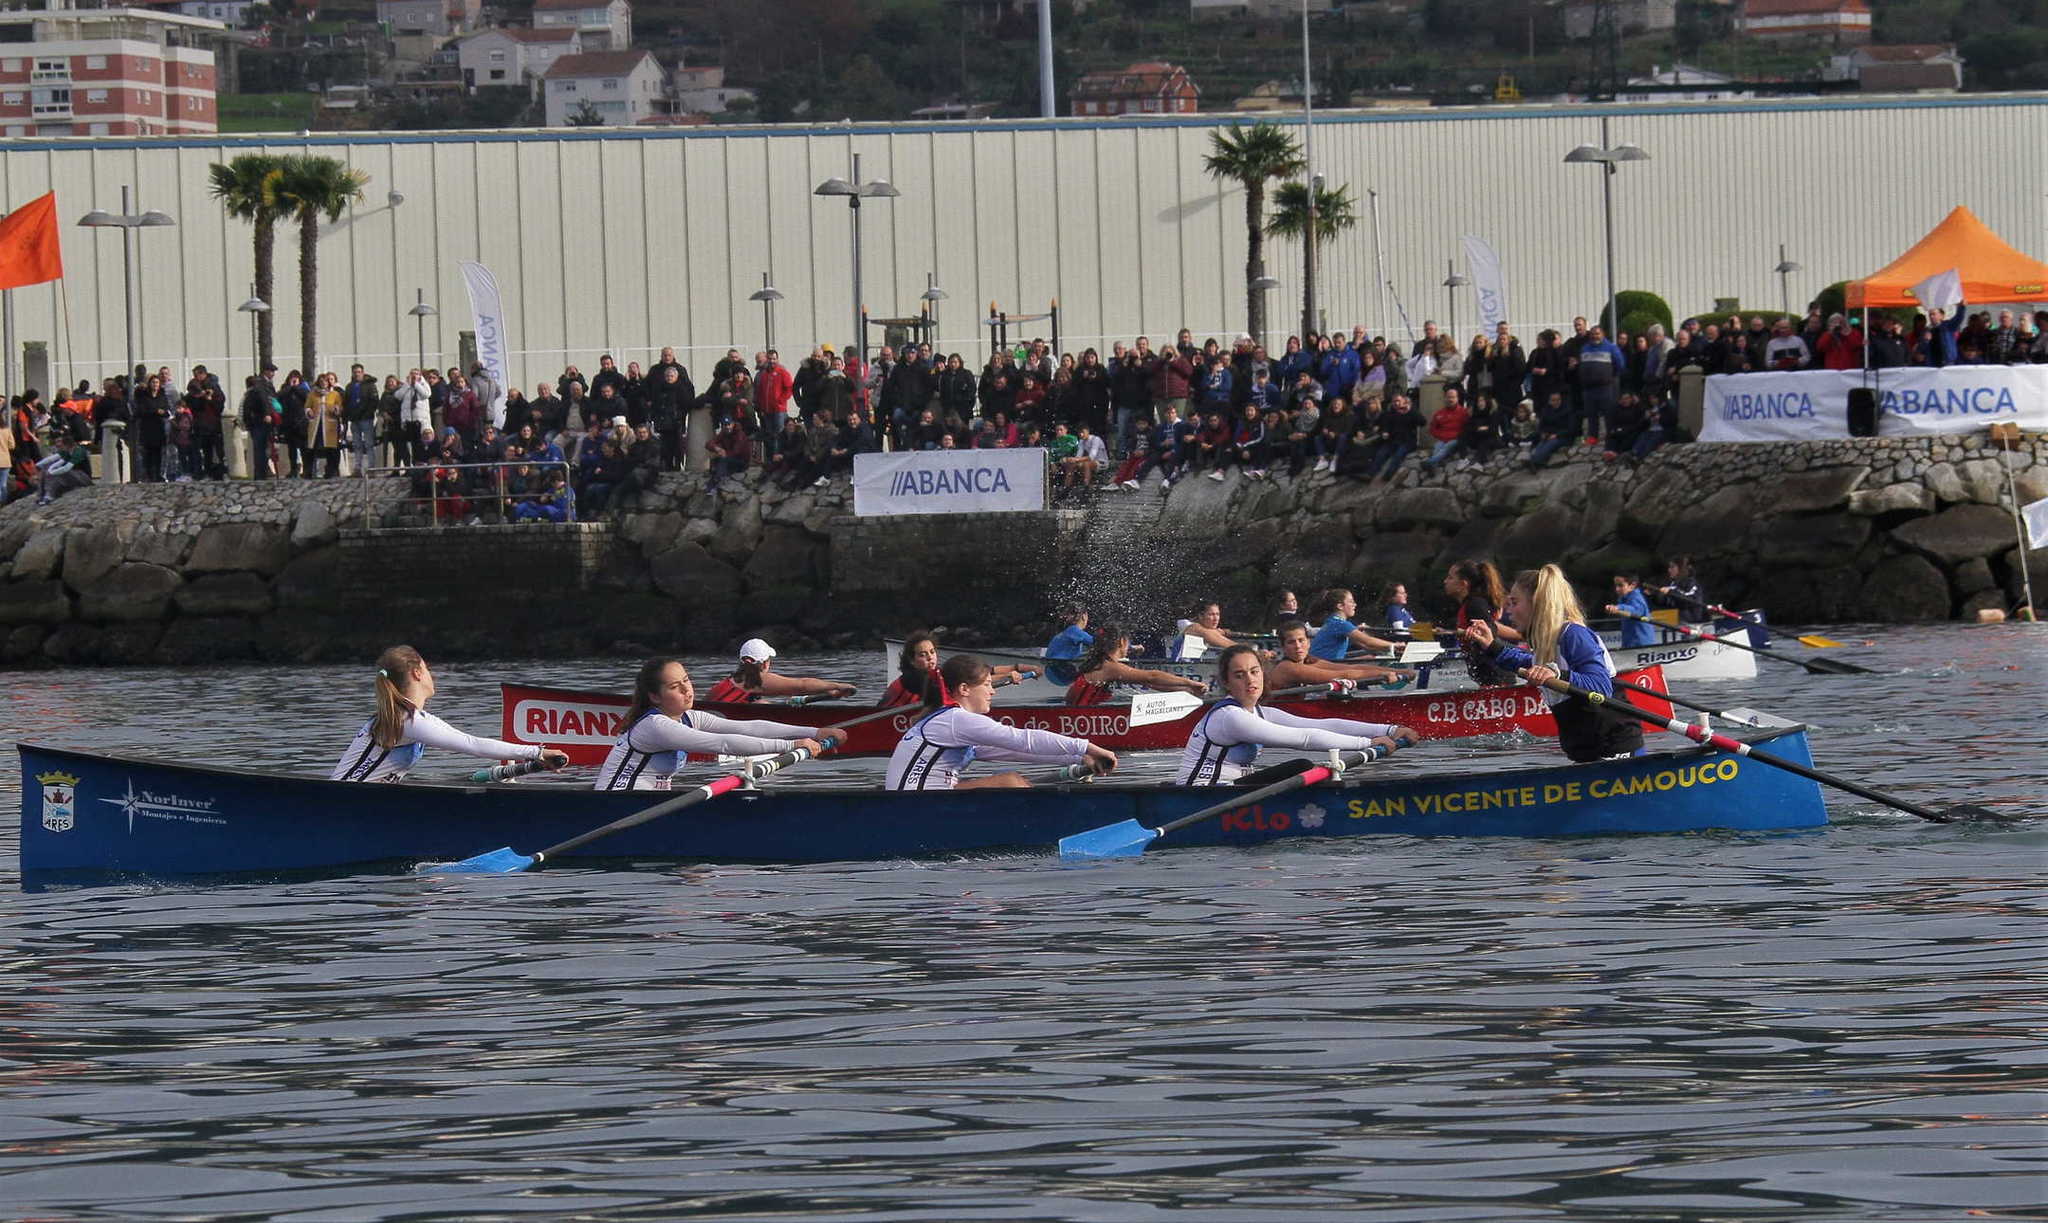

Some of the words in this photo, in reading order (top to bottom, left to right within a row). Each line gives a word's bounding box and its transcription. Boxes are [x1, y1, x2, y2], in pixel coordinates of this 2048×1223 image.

[1637, 647, 1698, 664] Rianxo
[1463, 698, 1517, 721] CABO
[526, 708, 627, 737] RIANX
[1059, 715, 1130, 736] BOIRO
[614, 763, 637, 790] ARES
[906, 758, 927, 785] ARES
[1199, 758, 1217, 780] RES
[1348, 798, 1407, 820] SAN
[1411, 787, 1536, 816] VICENTE
[1543, 783, 1582, 804] DE
[1587, 758, 1740, 799] CAMOUCO
